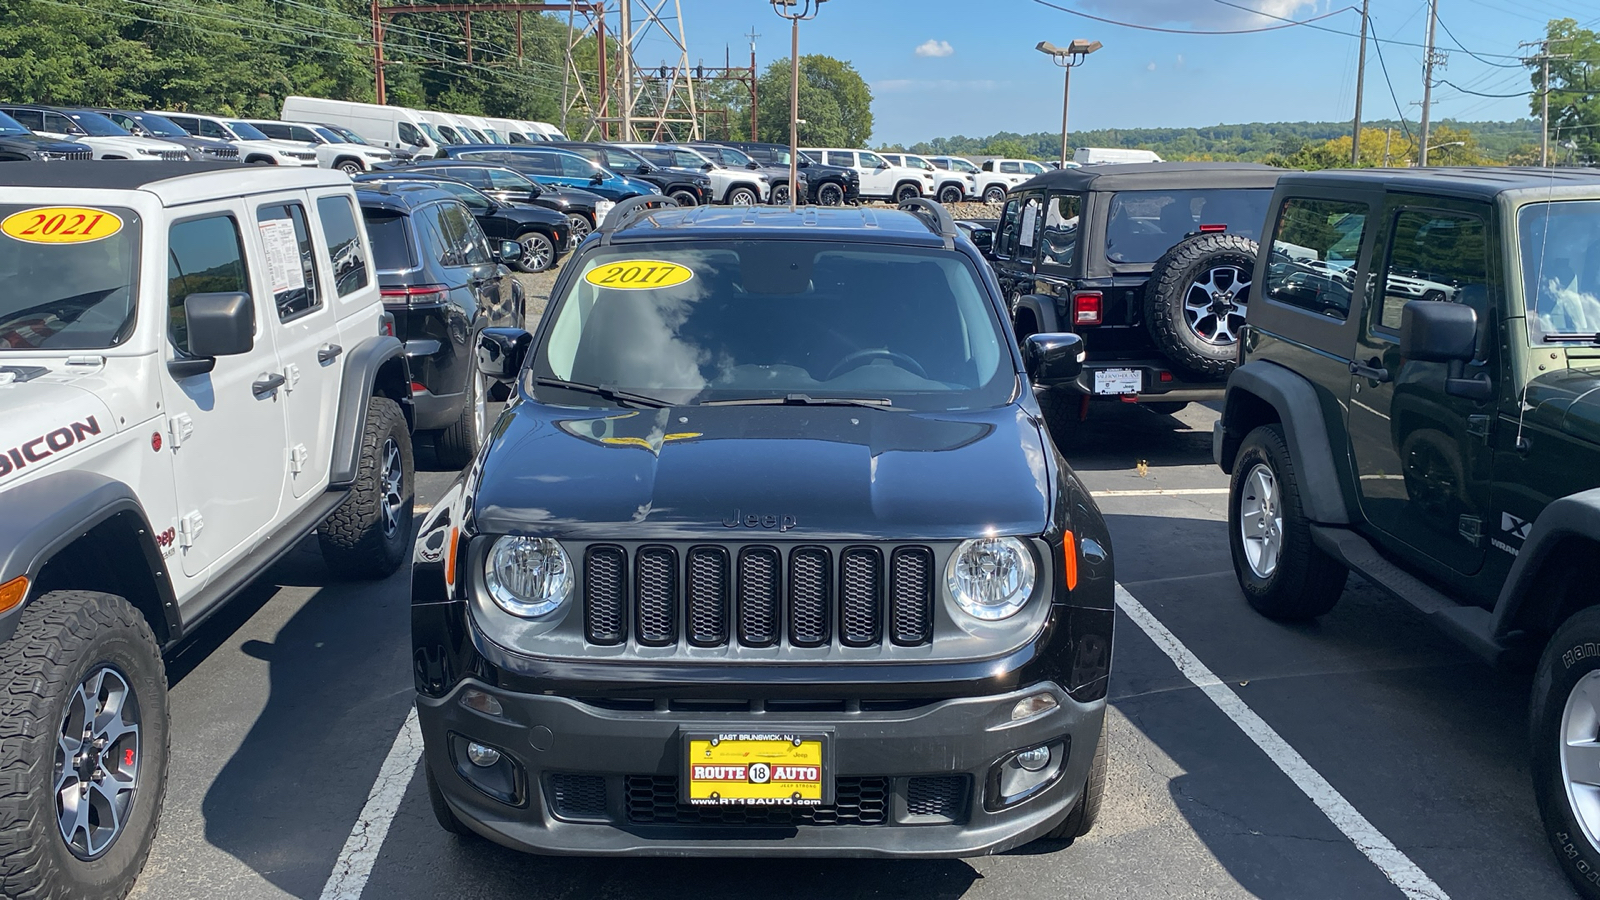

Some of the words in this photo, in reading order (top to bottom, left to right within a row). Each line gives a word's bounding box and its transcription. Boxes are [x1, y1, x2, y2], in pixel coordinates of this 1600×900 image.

[19, 213, 104, 235] 2021
[599, 266, 676, 284] 2017
[722, 508, 797, 533] Jeep
[1562, 642, 1600, 669] Han
[694, 766, 746, 779] ROUTE
[753, 767, 766, 779] 18
[773, 766, 817, 780] AUTO
